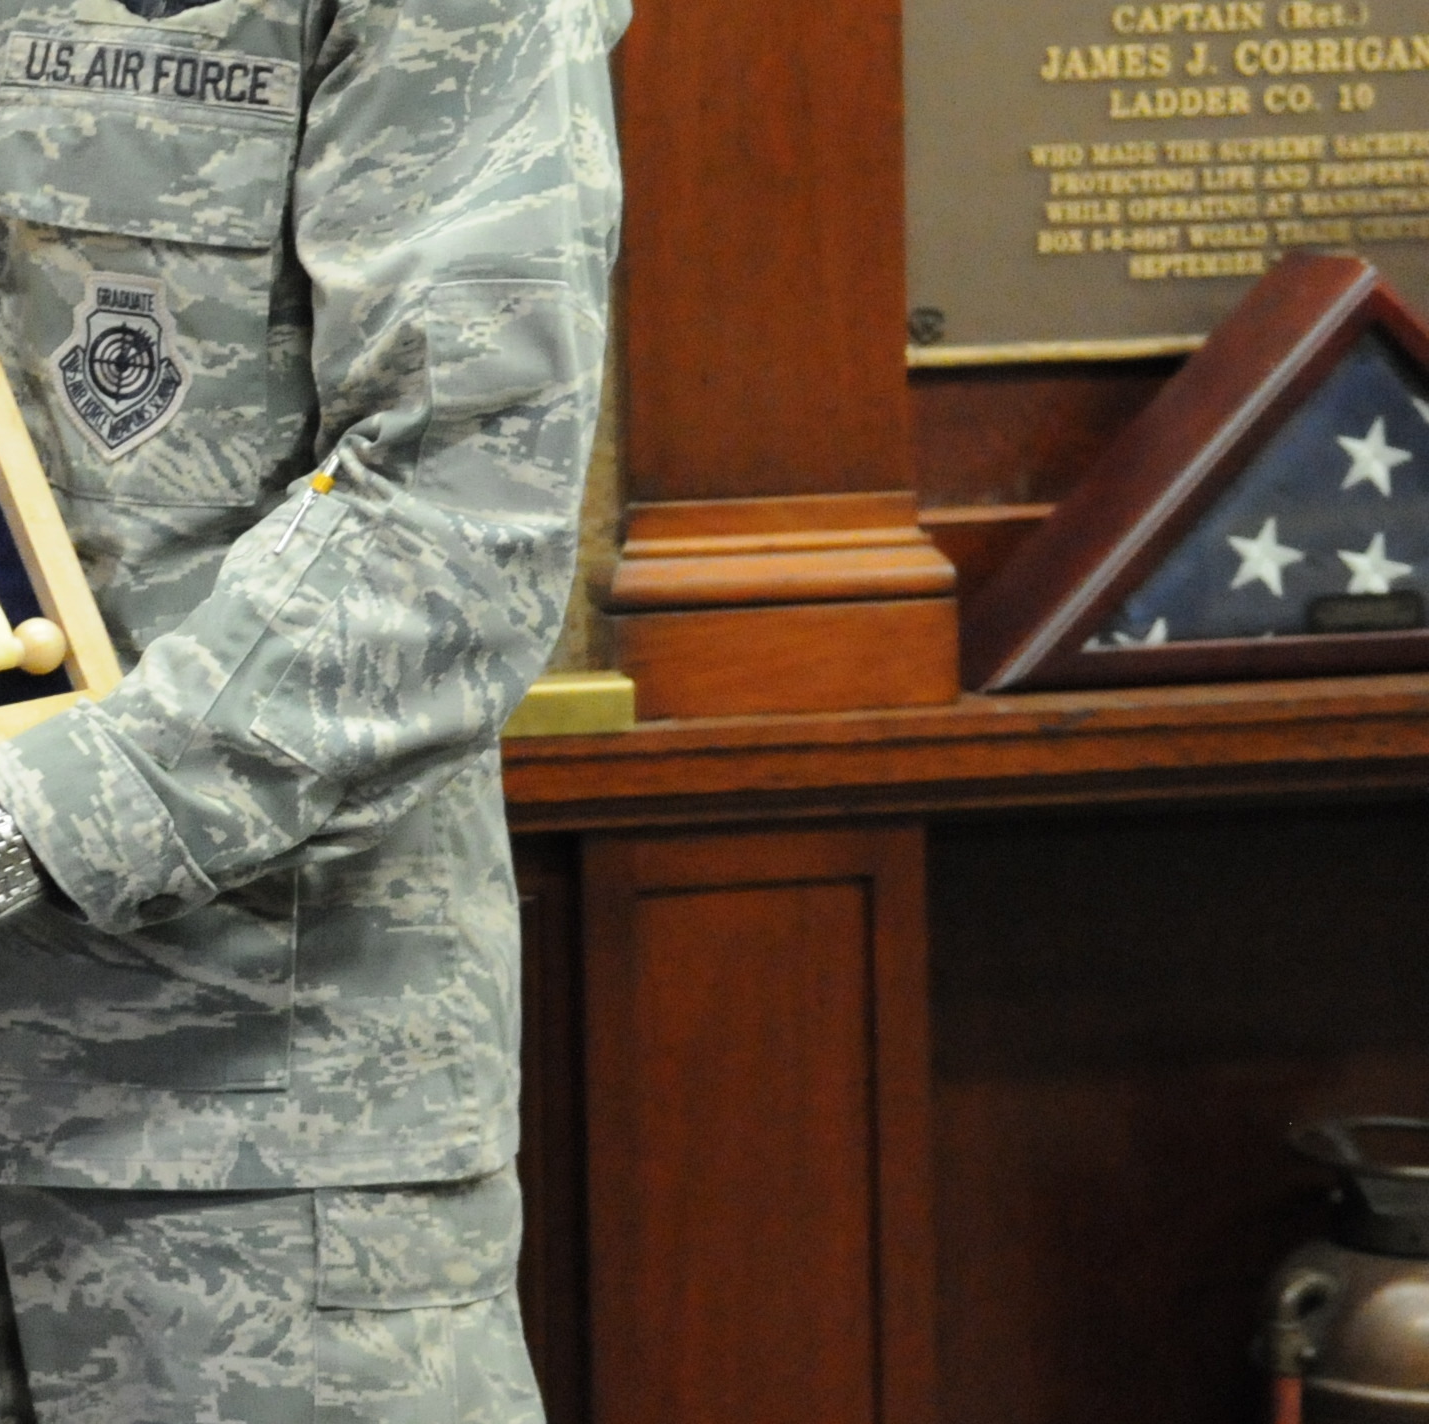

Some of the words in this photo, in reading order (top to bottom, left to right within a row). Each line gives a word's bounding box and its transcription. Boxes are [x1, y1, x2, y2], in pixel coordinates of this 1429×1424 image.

[1112, 2, 1263, 32] CAPTAIN
[25, 41, 76, 84] U.S.
[84, 45, 146, 91] AIR
[151, 53, 274, 105] FORCE
[1040, 43, 1171, 81] JAMES
[1185, 42, 1218, 76] J.
[1109, 85, 1250, 119] LADDER
[1264, 84, 1321, 112] CO.
[1340, 82, 1376, 111] 10
[96, 286, 155, 313] GRADUATE
